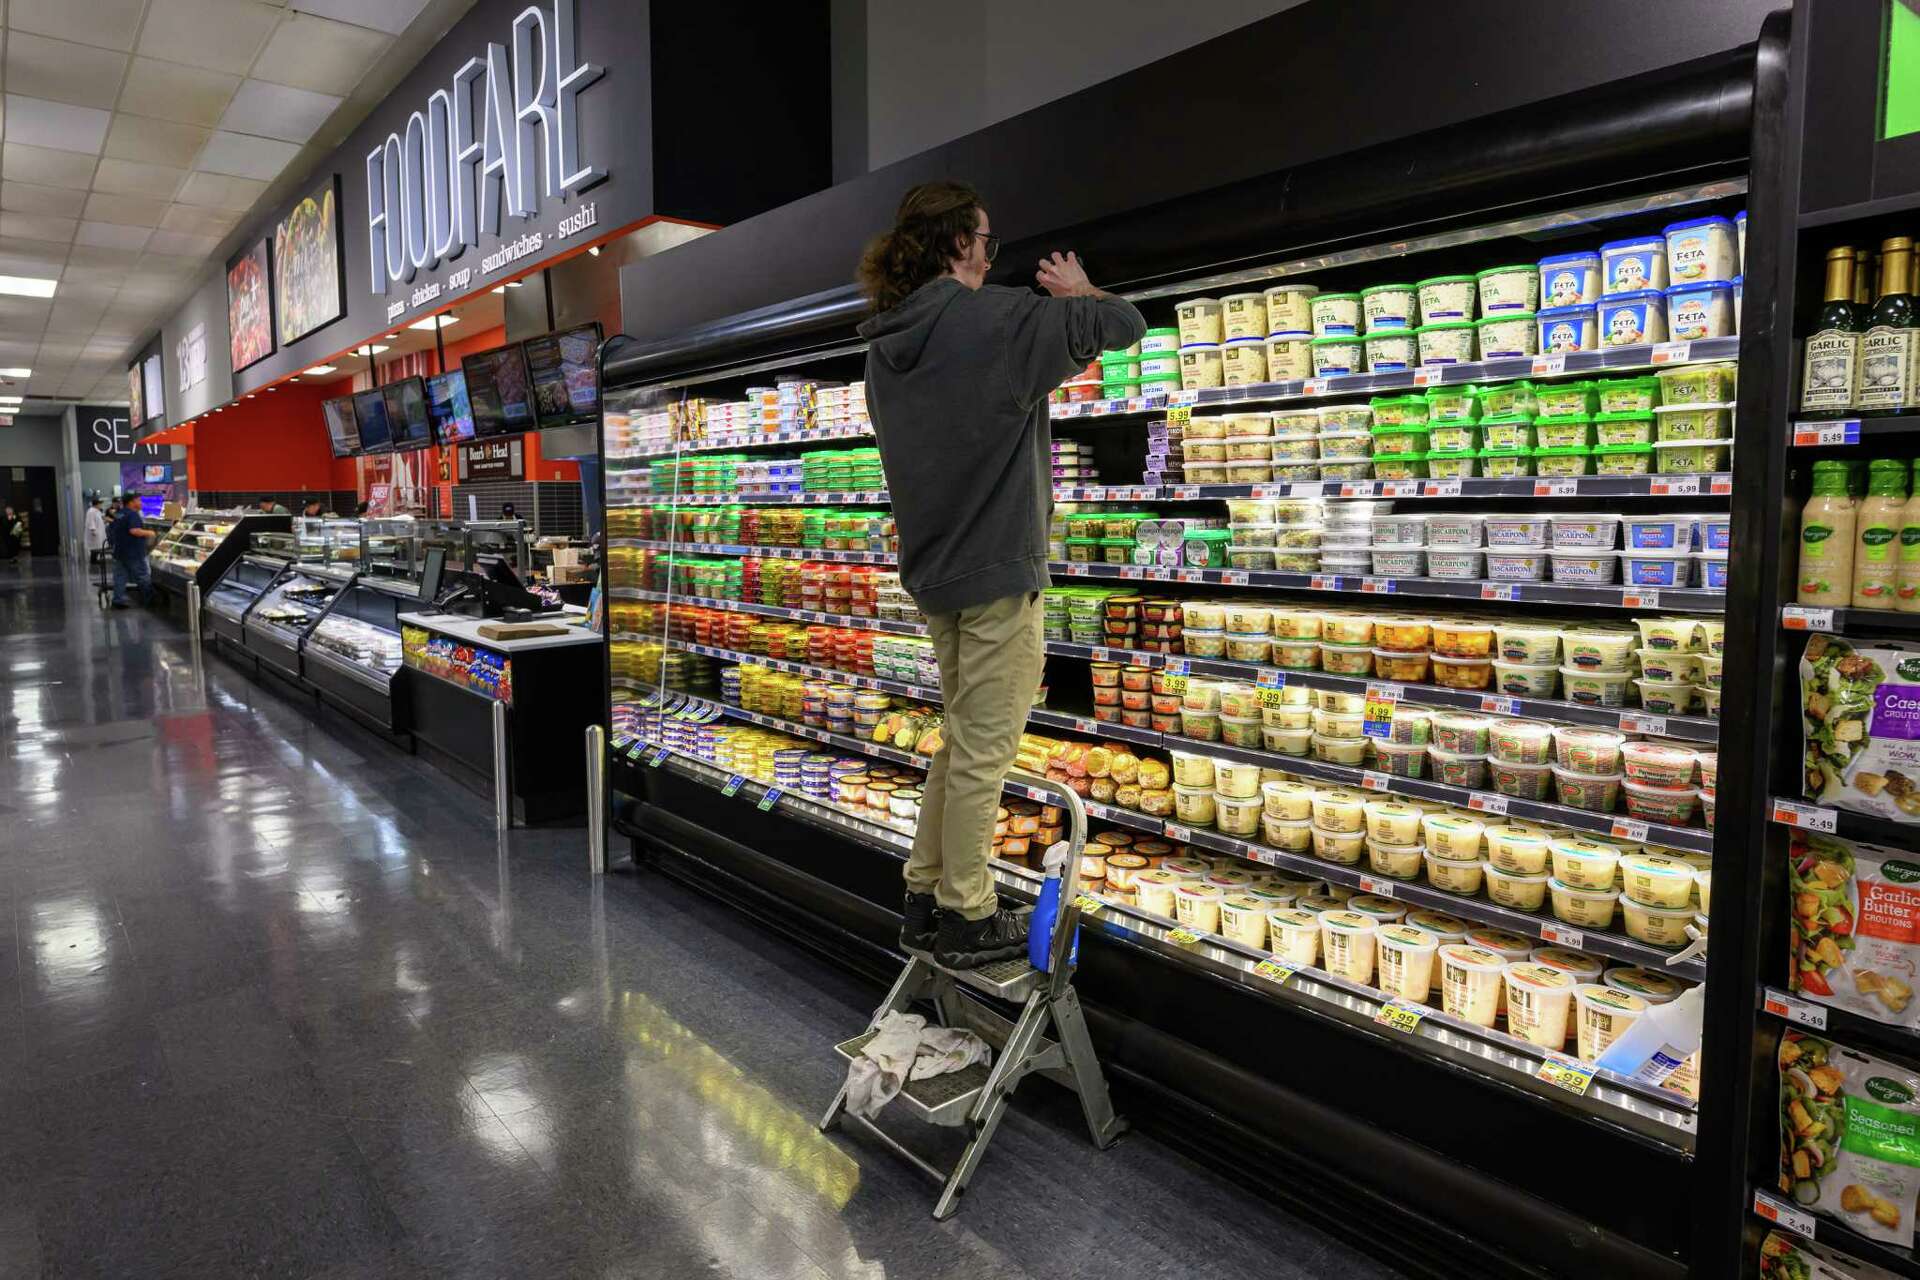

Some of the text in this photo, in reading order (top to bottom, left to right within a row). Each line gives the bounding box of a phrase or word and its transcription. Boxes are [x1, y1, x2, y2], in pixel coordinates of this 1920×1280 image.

[412, 283, 441, 308] chicken
[449, 267, 471, 289] soup
[481, 231, 543, 275] sandwiches
[558, 201, 598, 238] sushi
[1677, 249, 1705, 261] FETA
[1618, 266, 1643, 275] FETA
[1554, 281, 1576, 289] FETA
[1316, 314, 1337, 324] FETA
[1677, 311, 1706, 322] FETA
[1612, 318, 1636, 328] FETA
[1551, 332, 1573, 341] FETA
[1810, 339, 1850, 351] GARLIC
[1673, 386, 1697, 395] FETA
[1169, 410, 1188, 421] 5.99
[1670, 424, 1695, 433] FETA
[92, 418, 158, 455] SE
[1822, 432, 1842, 443] 5.49
[1670, 458, 1695, 467] FETA
[1678, 485, 1697, 494] 5.99
[1164, 678, 1186, 689] 3.99
[1257, 691, 1279, 703] 3.99
[1368, 706, 1389, 716] 4.99
[1809, 817, 1834, 830] 2.49
[1870, 886, 1920, 907] Garlic
[1864, 897, 1912, 918] Butter
[1864, 913, 1913, 929] CROUTONS
[1383, 1008, 1415, 1026] 5.99
[1799, 1011, 1824, 1027] 2.49
[1849, 1108, 1916, 1136] Seasoned
[1787, 1217, 1813, 1235] 2.49
